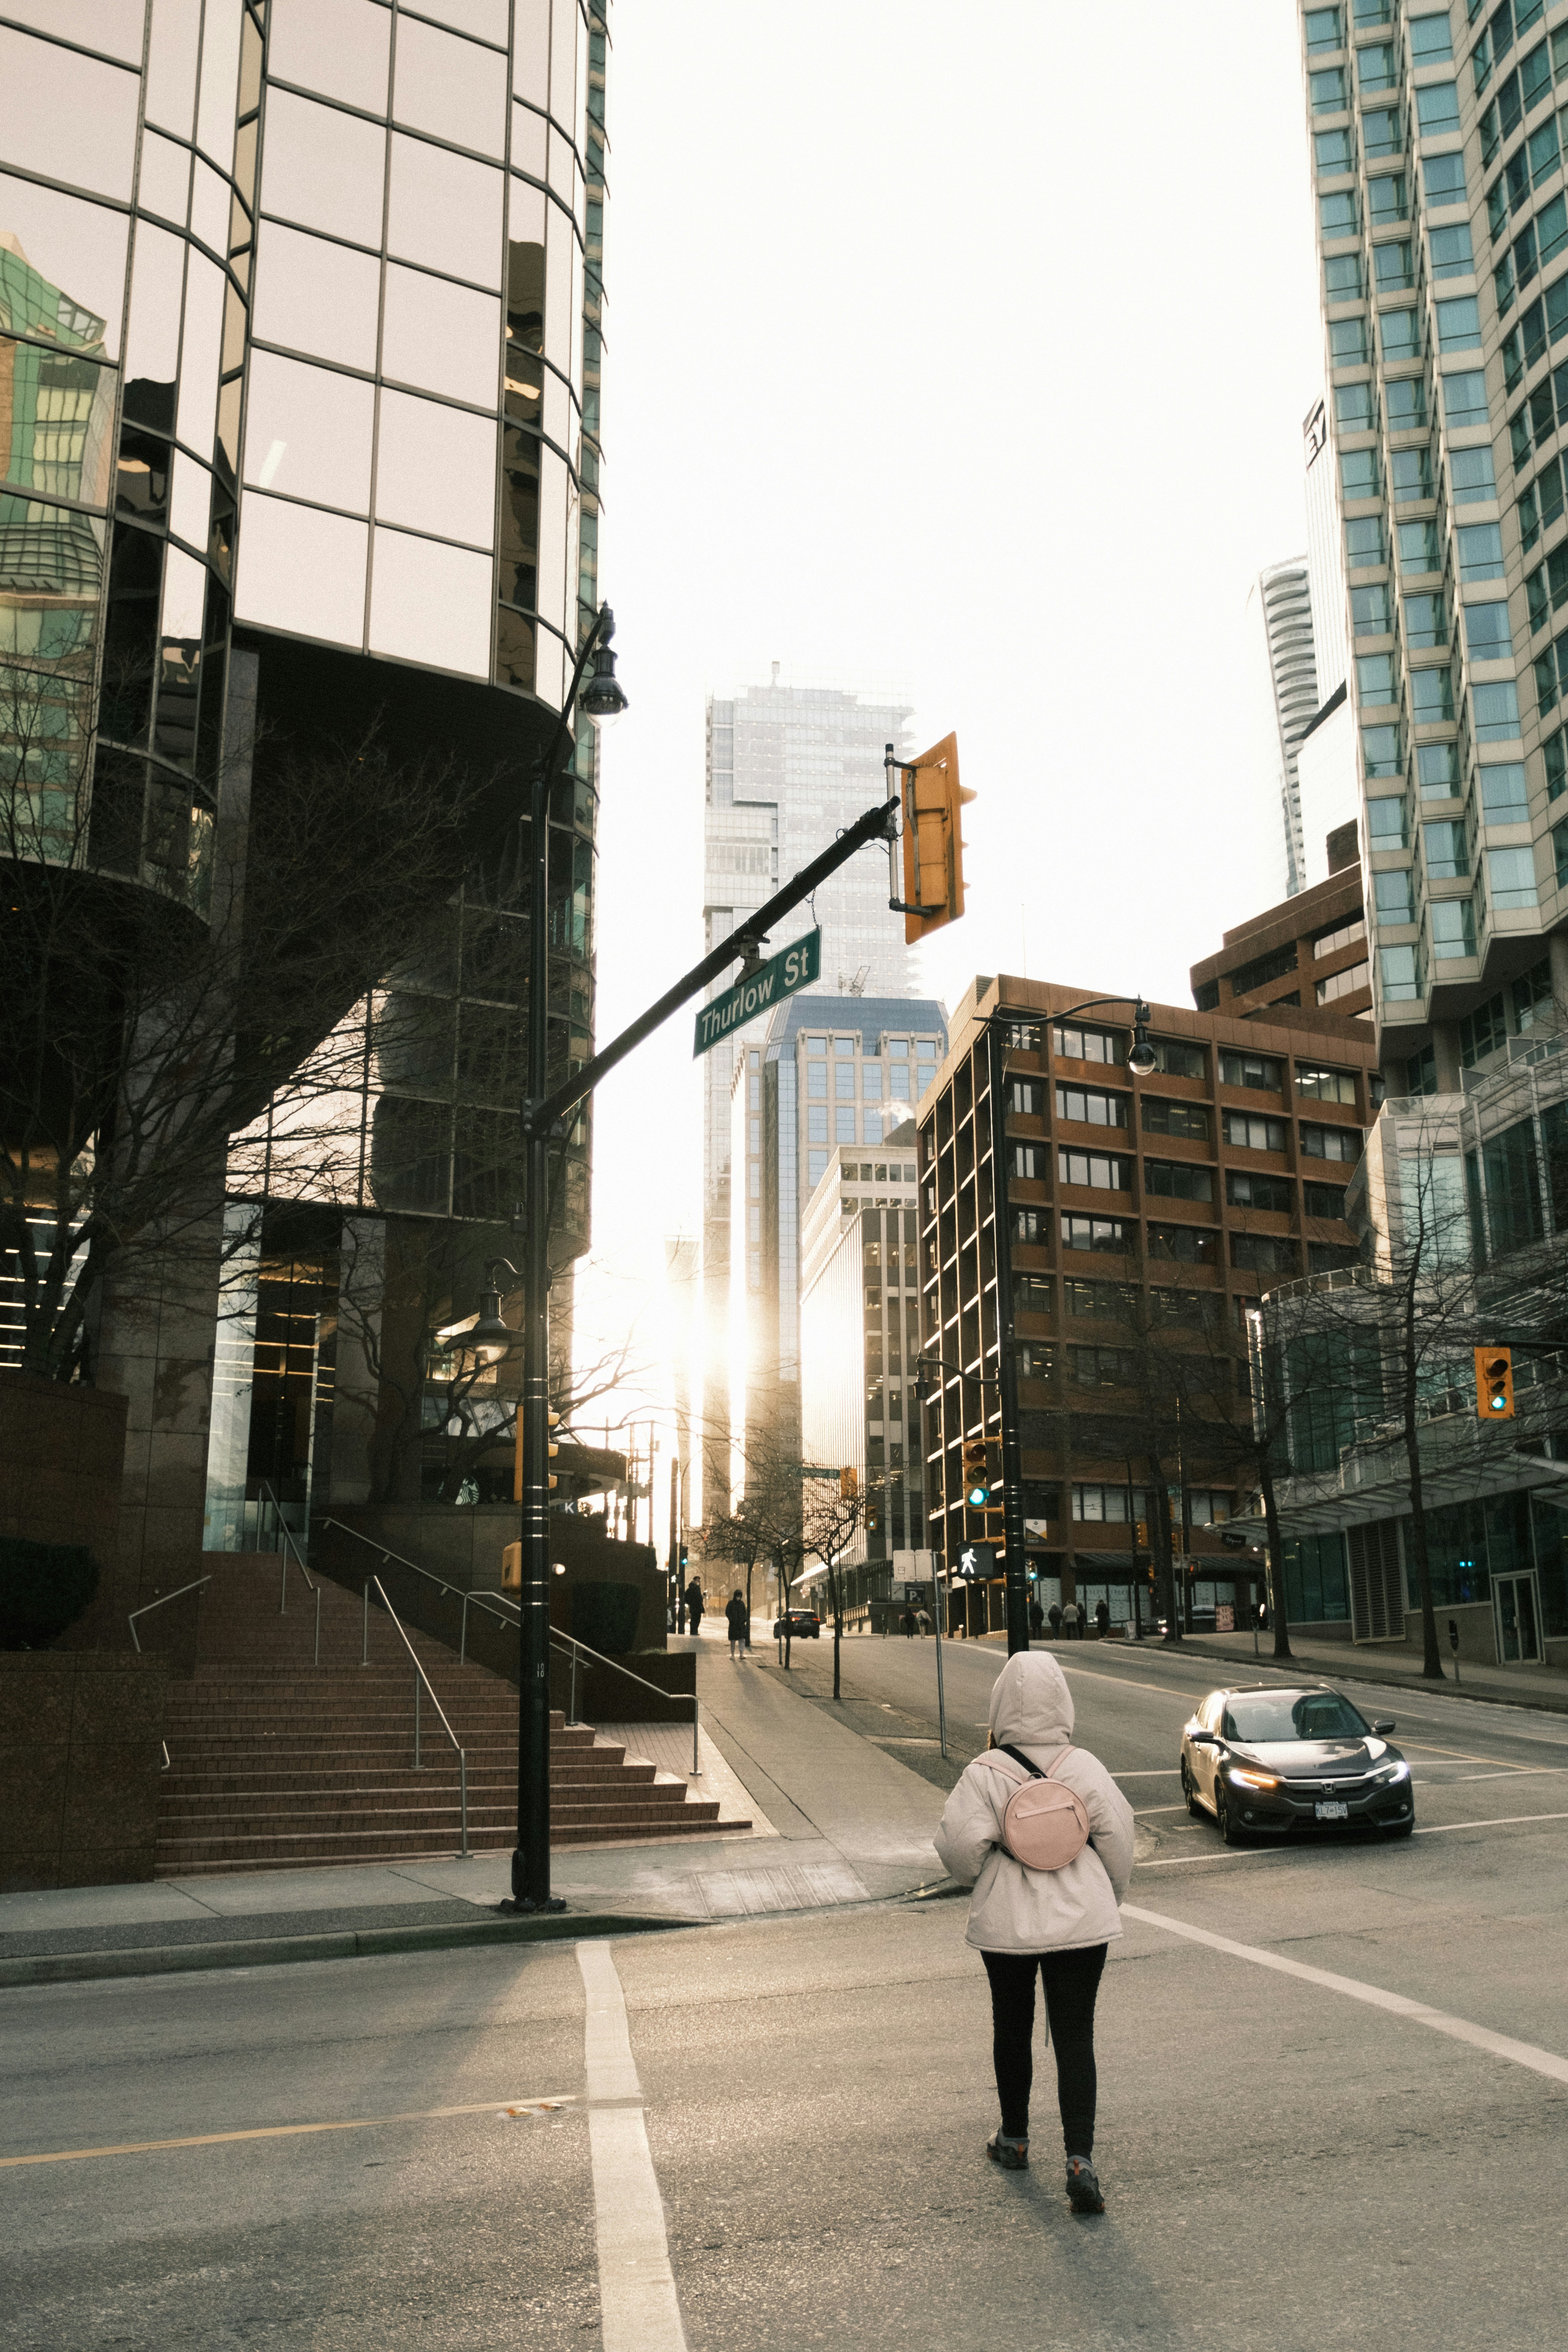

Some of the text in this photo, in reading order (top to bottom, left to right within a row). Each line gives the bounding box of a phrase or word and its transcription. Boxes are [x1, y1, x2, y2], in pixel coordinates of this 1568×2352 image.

[702, 946, 809, 1043] Thurlow St
[910, 1591, 917, 1601] P
[1316, 1806, 1347, 1815] KL7 15V
